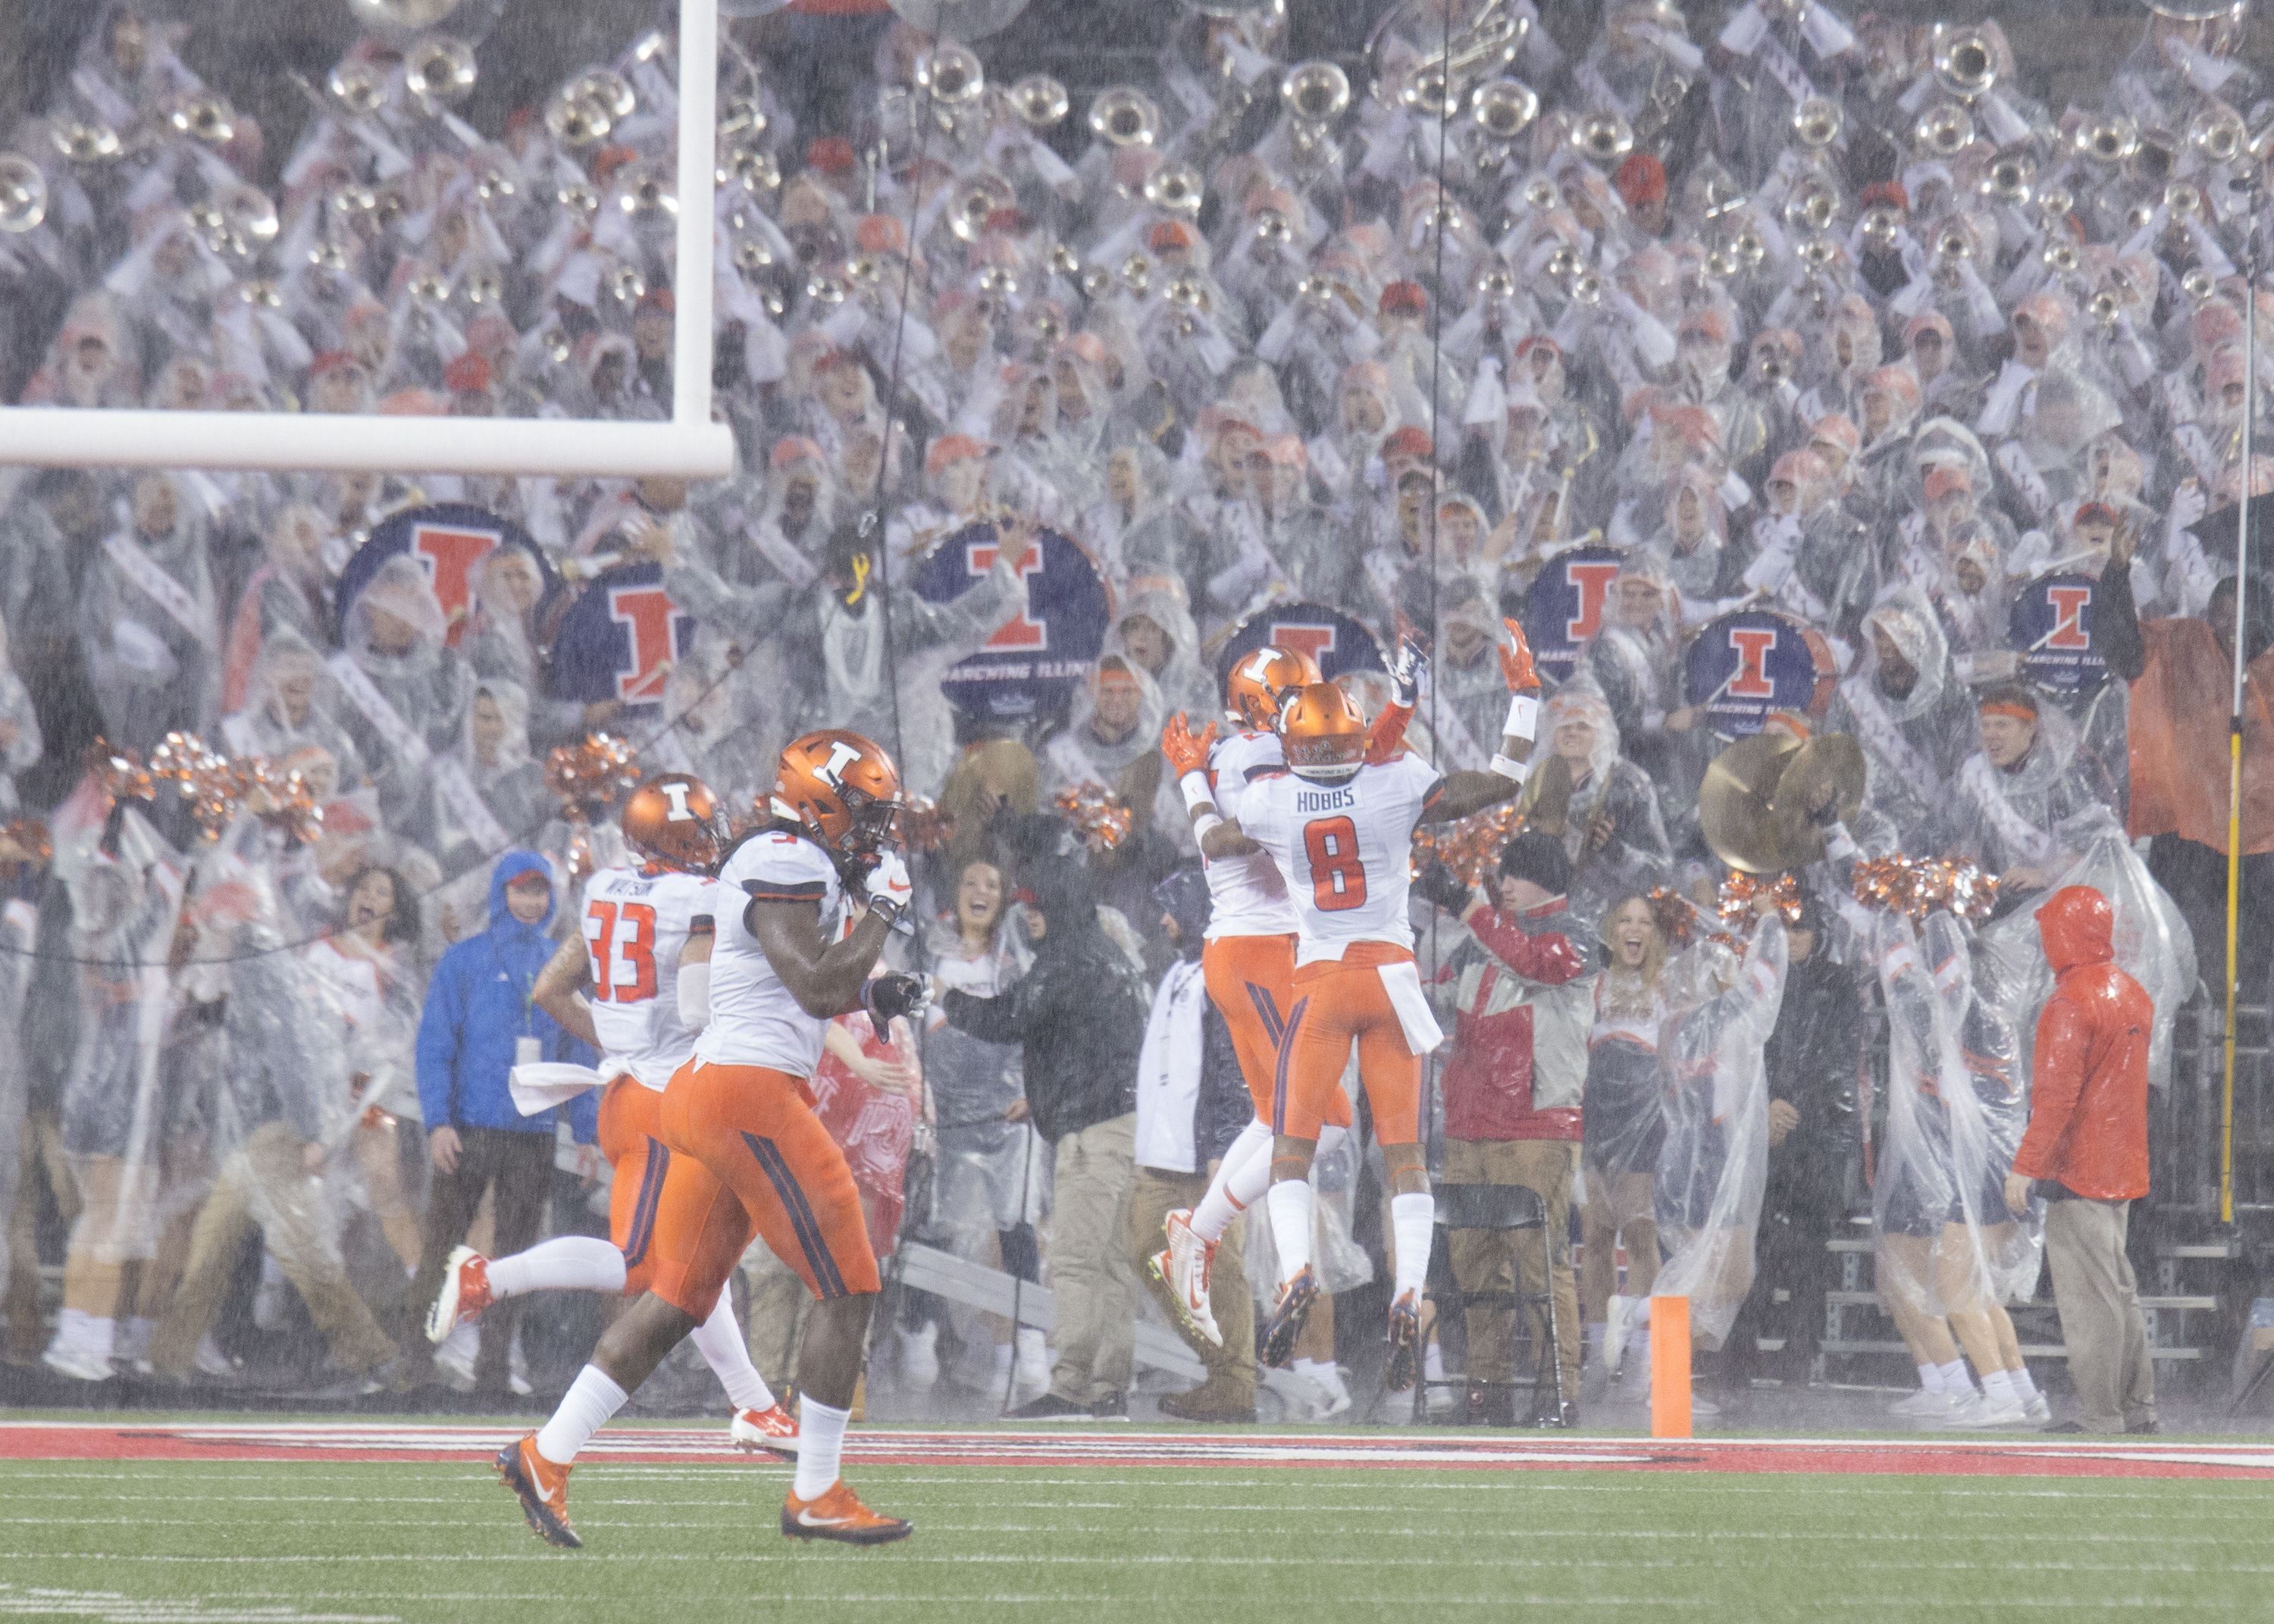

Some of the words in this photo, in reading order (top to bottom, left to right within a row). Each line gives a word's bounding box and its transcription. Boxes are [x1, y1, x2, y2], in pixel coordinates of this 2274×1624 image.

[1568, 562, 1620, 641] I
[2047, 586, 2091, 649] I
[609, 585, 683, 702] I
[1244, 648, 1282, 681] I
[1728, 628, 1775, 698] I
[813, 741, 861, 786] I
[662, 783, 693, 821] I
[1297, 787, 1355, 812] HOBBS
[1304, 815, 1367, 912] 8
[587, 900, 657, 1003] 33
